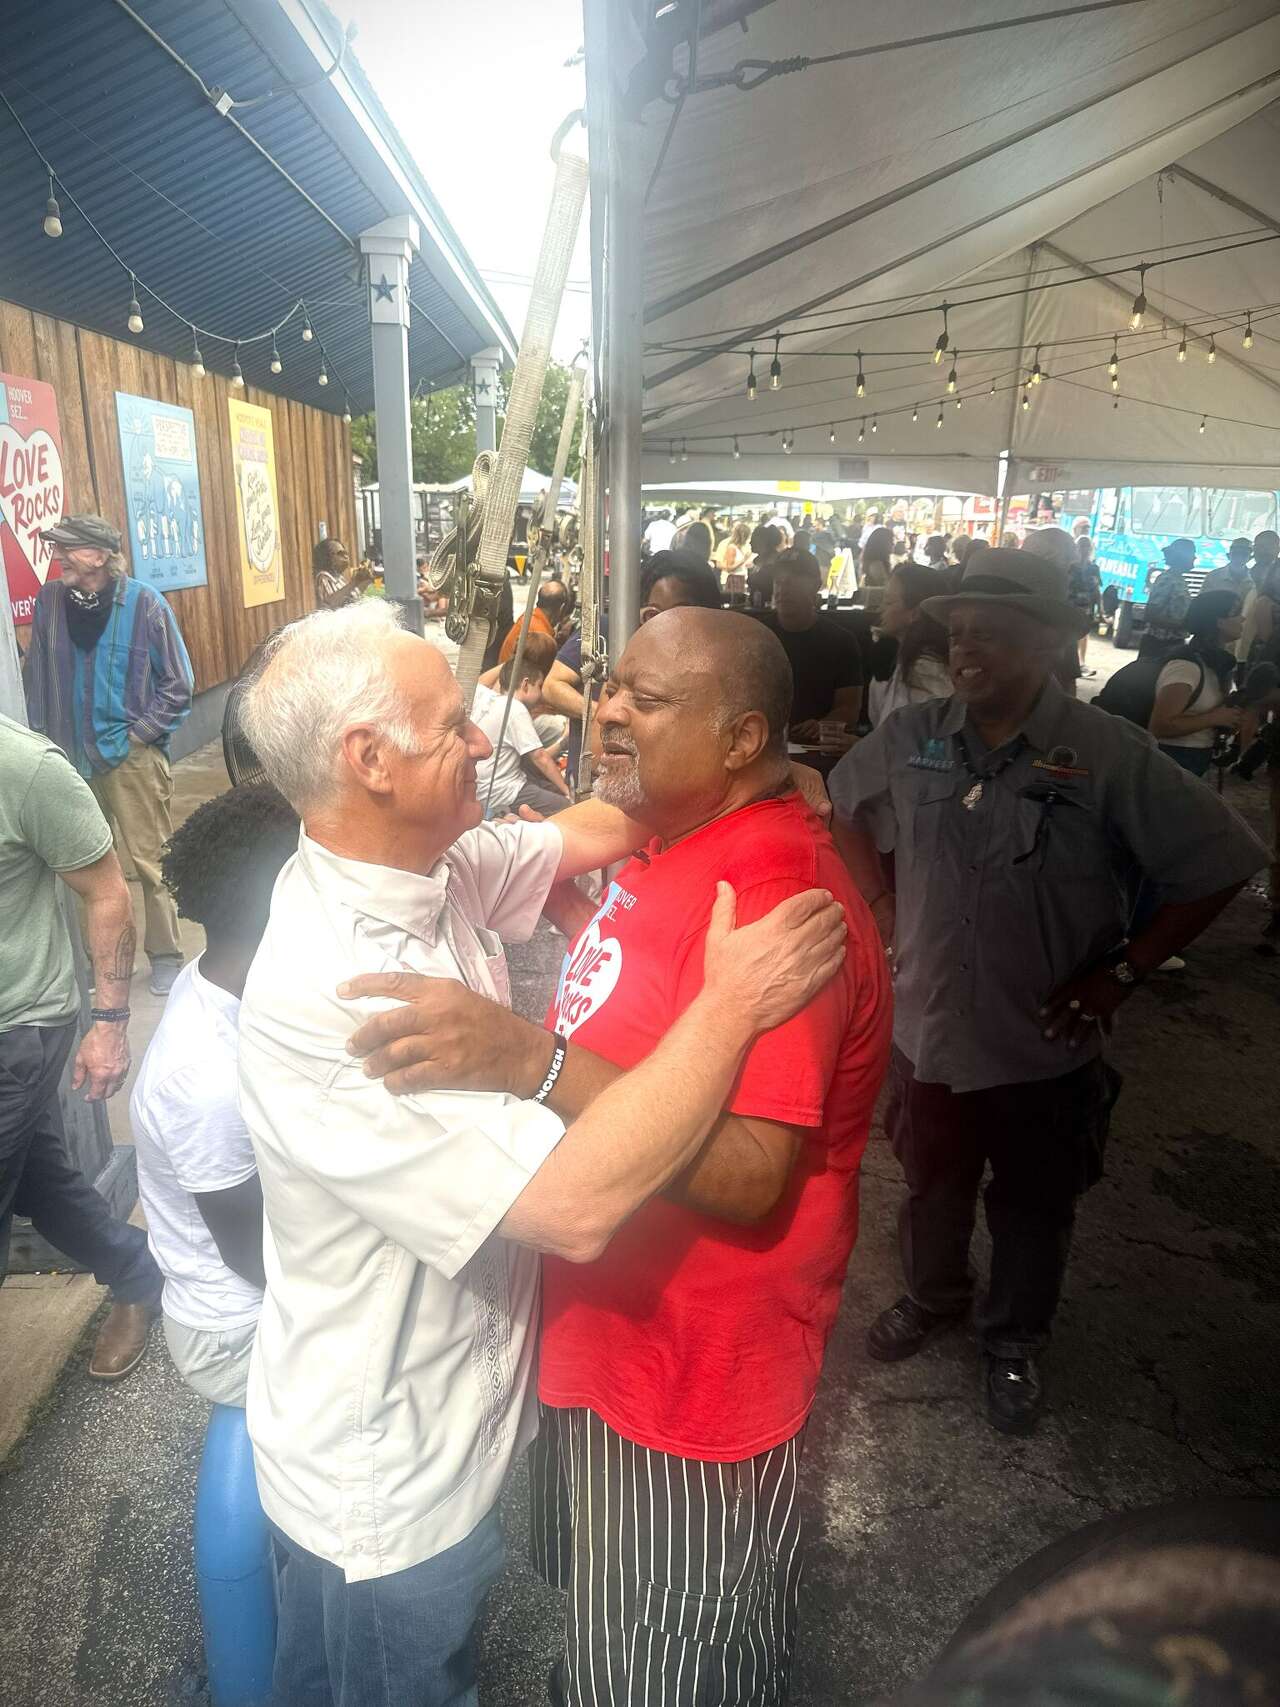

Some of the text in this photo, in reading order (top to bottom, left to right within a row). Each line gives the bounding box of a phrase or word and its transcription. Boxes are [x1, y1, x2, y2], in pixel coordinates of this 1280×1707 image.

[8, 386, 32, 405] HOOVER
[0, 440, 49, 497] LOVE
[11, 484, 60, 534] ROCKS
